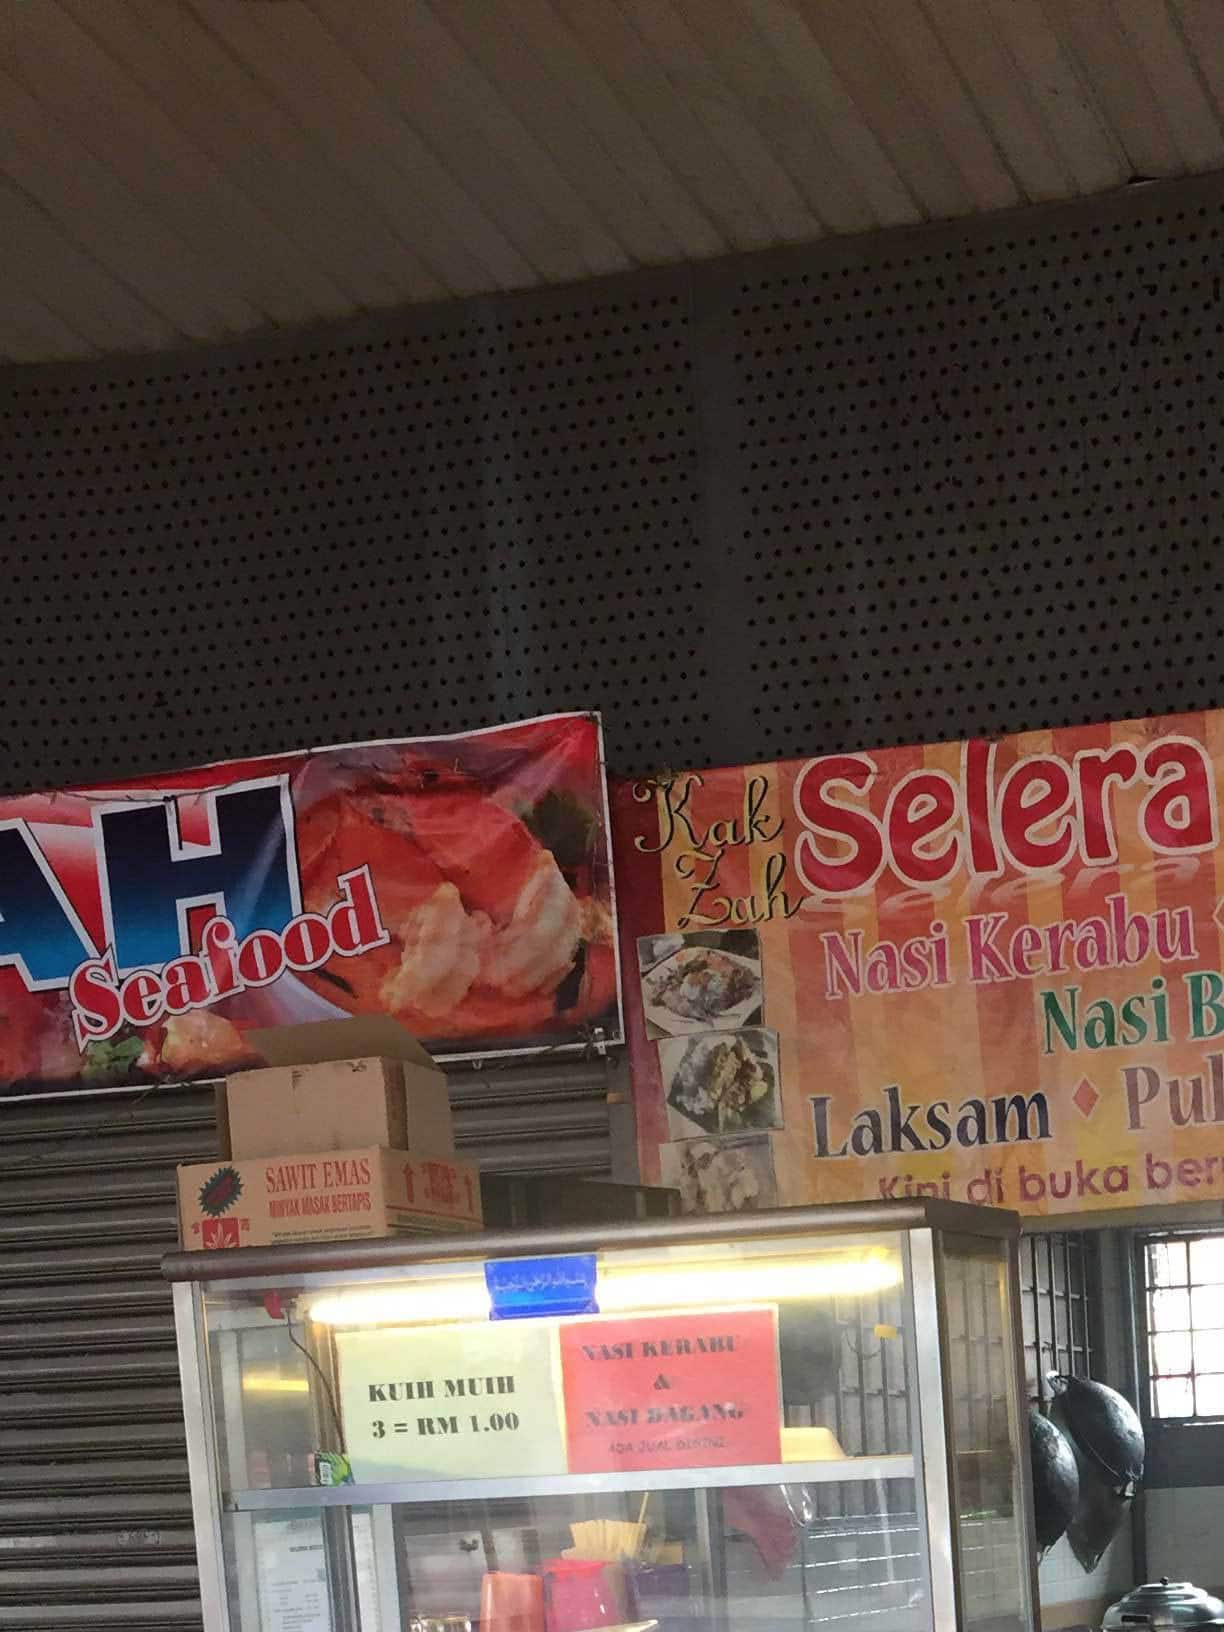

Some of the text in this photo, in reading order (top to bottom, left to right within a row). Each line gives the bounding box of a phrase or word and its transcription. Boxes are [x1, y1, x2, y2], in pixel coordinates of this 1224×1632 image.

[633, 775, 784, 853] Kak
[795, 734, 1217, 900] Selera
[70, 864, 390, 1052] Seafood
[822, 922, 949, 1000] Nasi
[965, 894, 1195, 985] Kerabu
[1041, 978, 1169, 1055] Nasi
[810, 1085, 1053, 1160] Laksam
[265, 1157, 371, 1193] SAWIT EMAS
[878, 1170, 951, 1201] Kini
[966, 1165, 1005, 1207] di
[1018, 1158, 1130, 1203] buka
[582, 1342, 635, 1361] NASI
[368, 1375, 515, 1402] KUIH MUIH
[653, 1374, 671, 1390] &
[372, 1420, 386, 1439] 3
[416, 1416, 459, 1435] RM
[469, 1412, 520, 1432] 1.00
[586, 1409, 639, 1428] NASI
